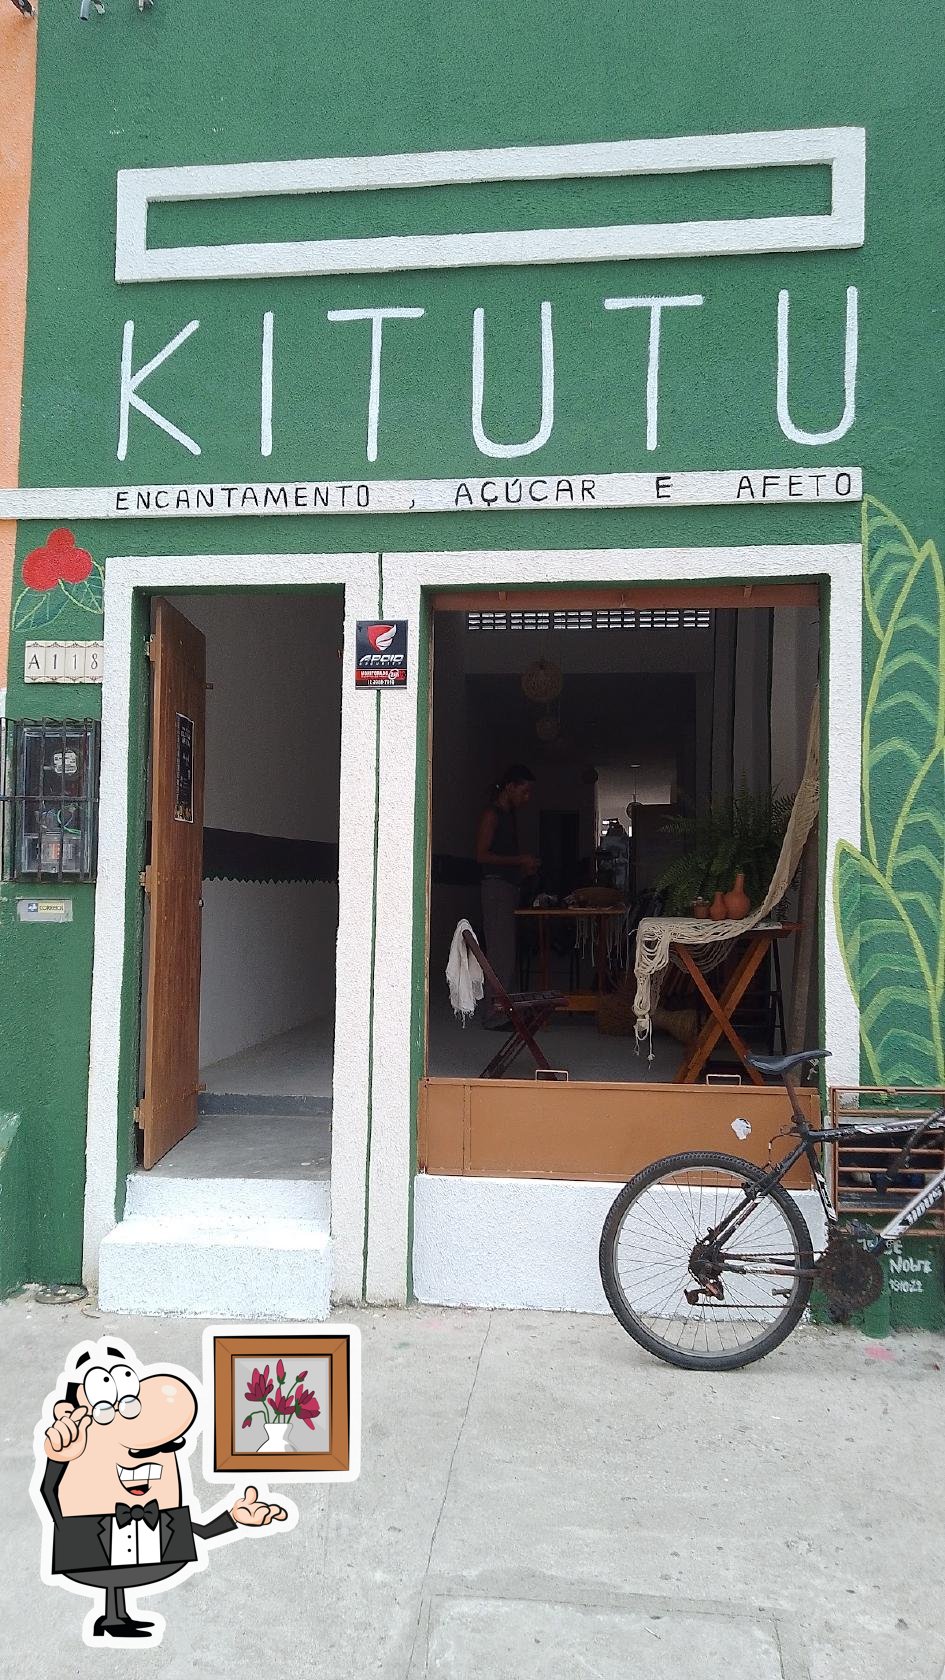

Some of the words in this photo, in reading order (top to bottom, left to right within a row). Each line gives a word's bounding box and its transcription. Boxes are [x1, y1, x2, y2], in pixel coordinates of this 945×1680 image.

[116, 285, 858, 462] KITUTU
[115, 484, 370, 511] ENCANTAMENTO
[455, 478, 597, 507] AÇÚCAR
[656, 476, 672, 499] E
[736, 472, 852, 500] AFETO
[28, 653, 98, 670] A118
